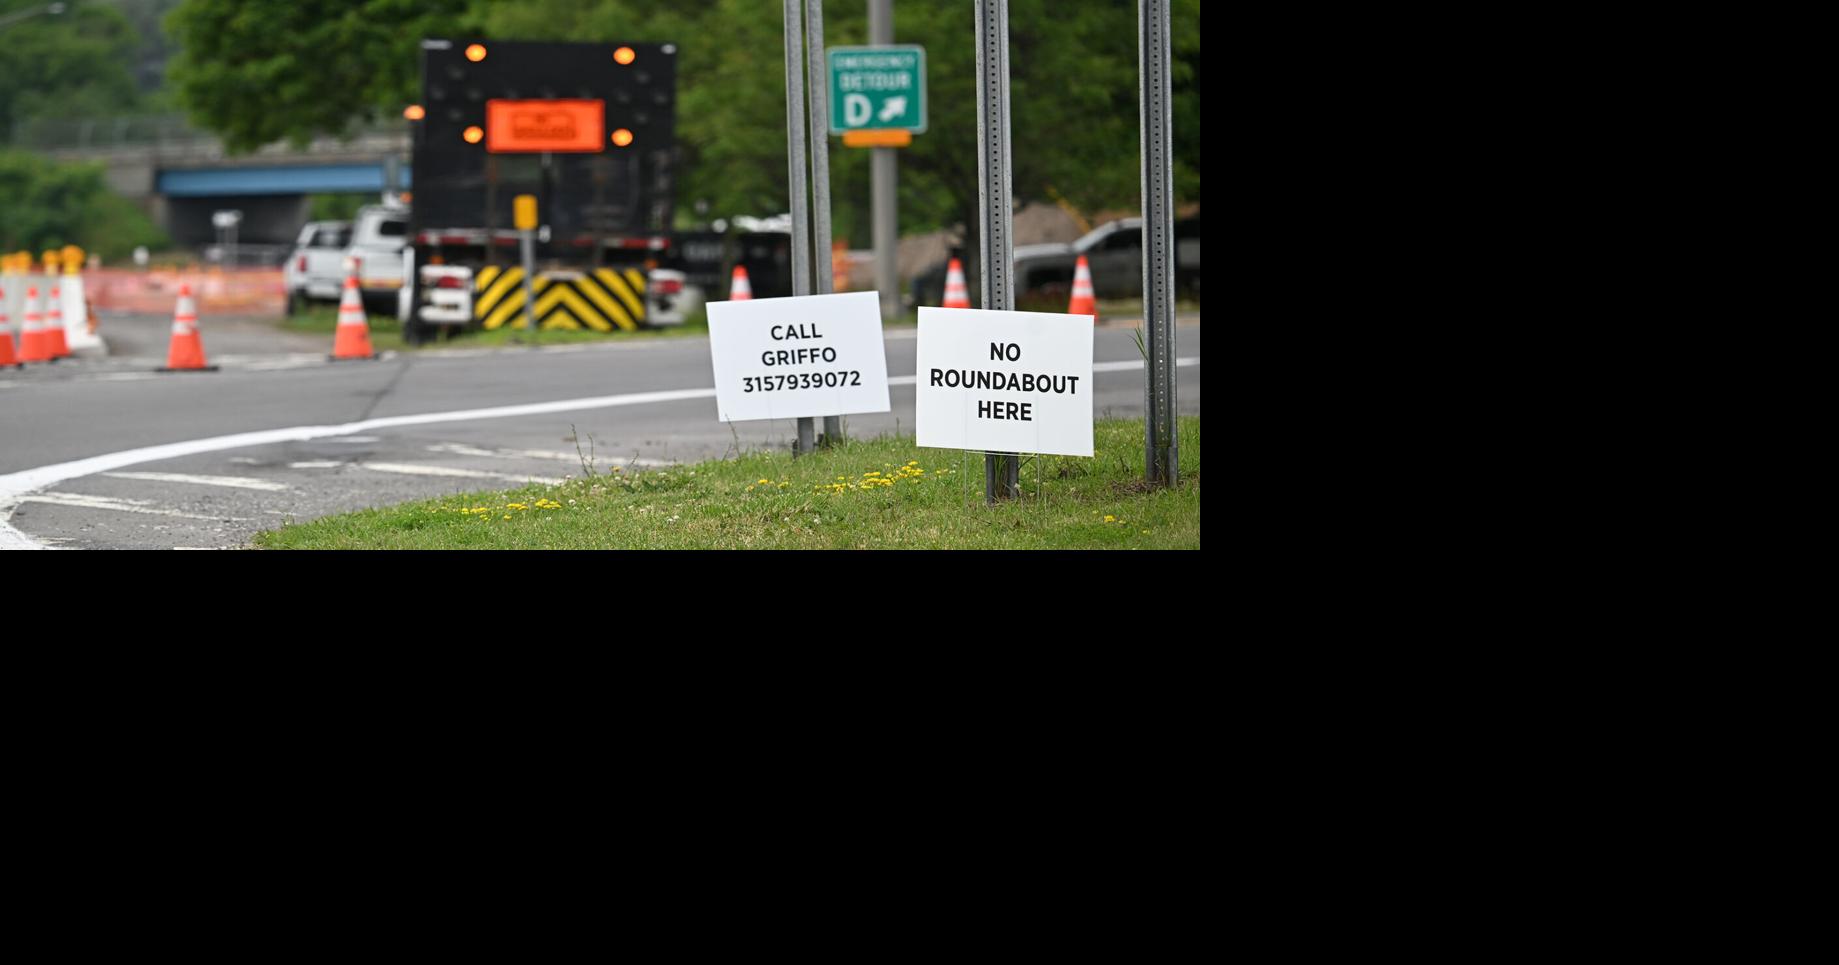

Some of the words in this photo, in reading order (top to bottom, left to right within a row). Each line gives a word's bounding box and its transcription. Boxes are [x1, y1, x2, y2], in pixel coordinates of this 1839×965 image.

[839, 72, 911, 91] DETOUR
[844, 94, 872, 127] D
[771, 323, 823, 340] CALL
[762, 347, 837, 366] GRIFFO
[990, 343, 1021, 361] NO
[743, 371, 861, 393] 3157939072
[930, 369, 1079, 394] ROUNDABOUT
[978, 401, 1032, 421] HERE
